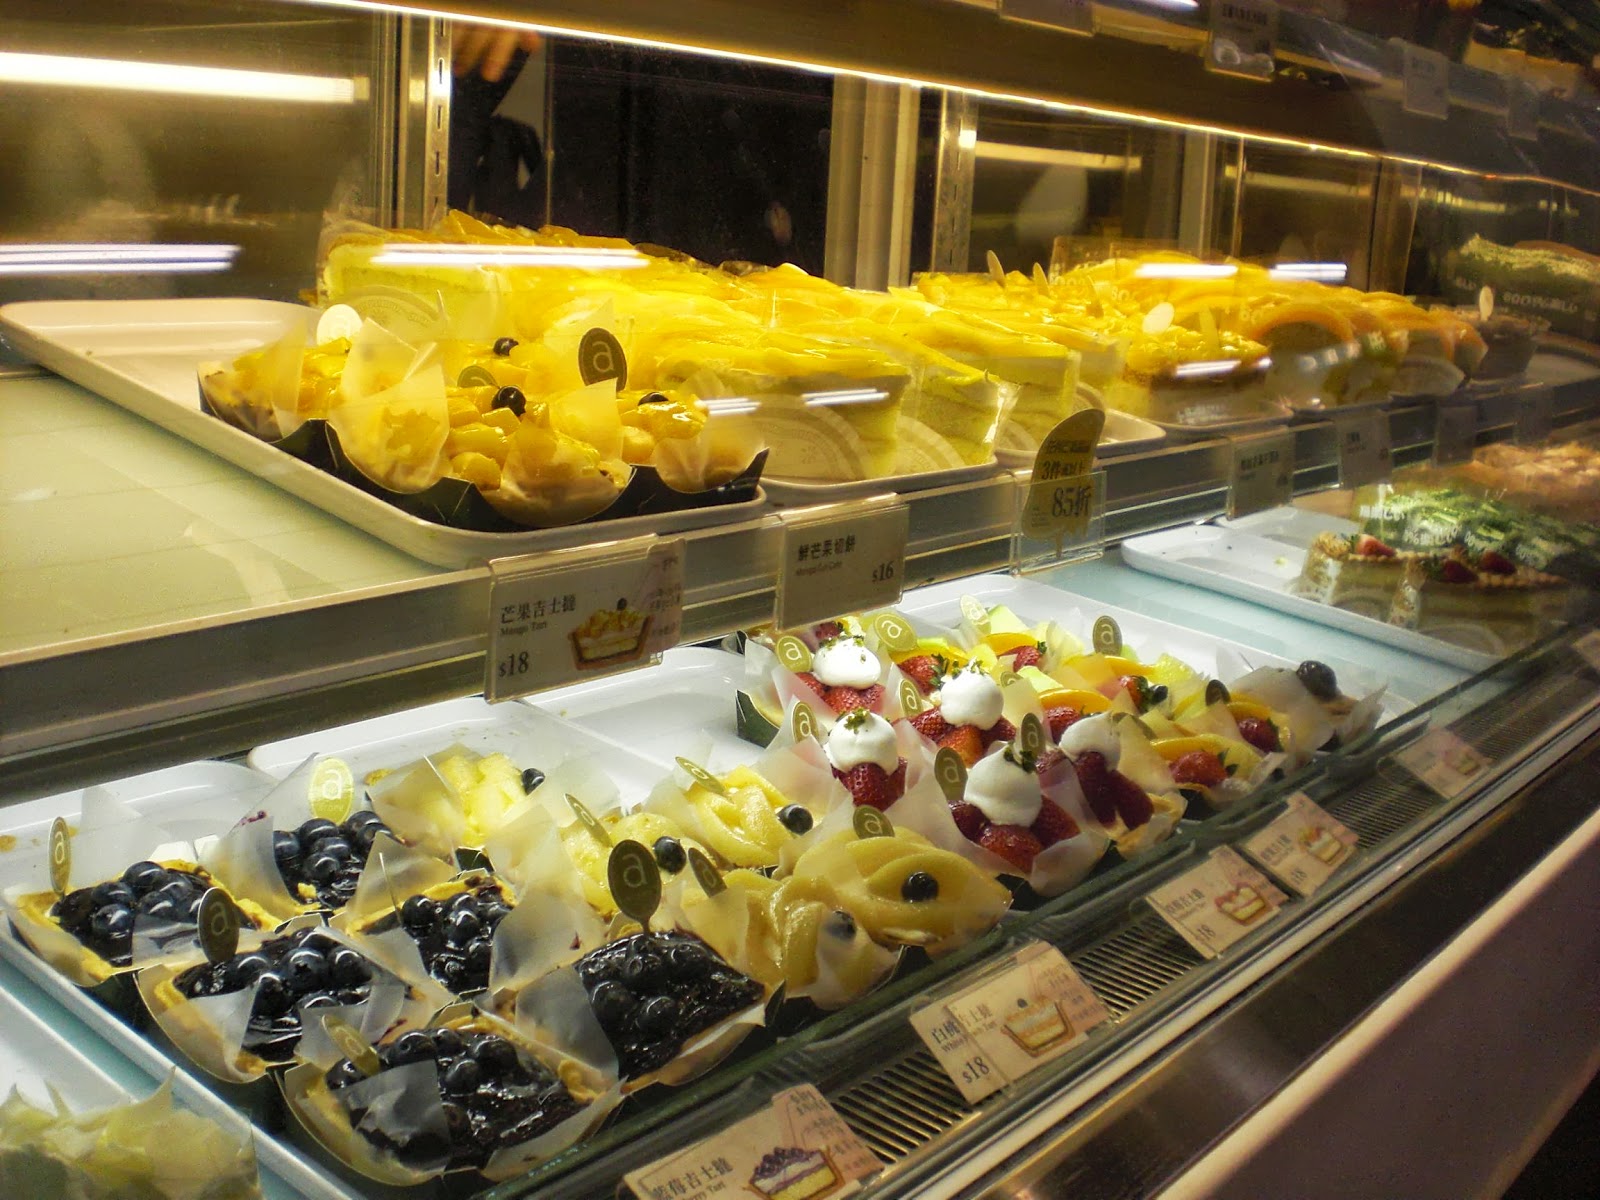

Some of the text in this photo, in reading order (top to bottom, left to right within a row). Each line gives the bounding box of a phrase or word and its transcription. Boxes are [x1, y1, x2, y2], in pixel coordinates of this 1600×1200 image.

[590, 341, 613, 371] a
[882, 620, 902, 640] a
[1101, 624, 1114, 644] a
[786, 641, 803, 661] a
[906, 686, 918, 707] a
[800, 712, 812, 732] a
[947, 762, 960, 783] a
[321, 770, 343, 799] a
[864, 815, 884, 835] a
[55, 832, 66, 863] a
[622, 853, 648, 888] a
[211, 902, 233, 936] a
